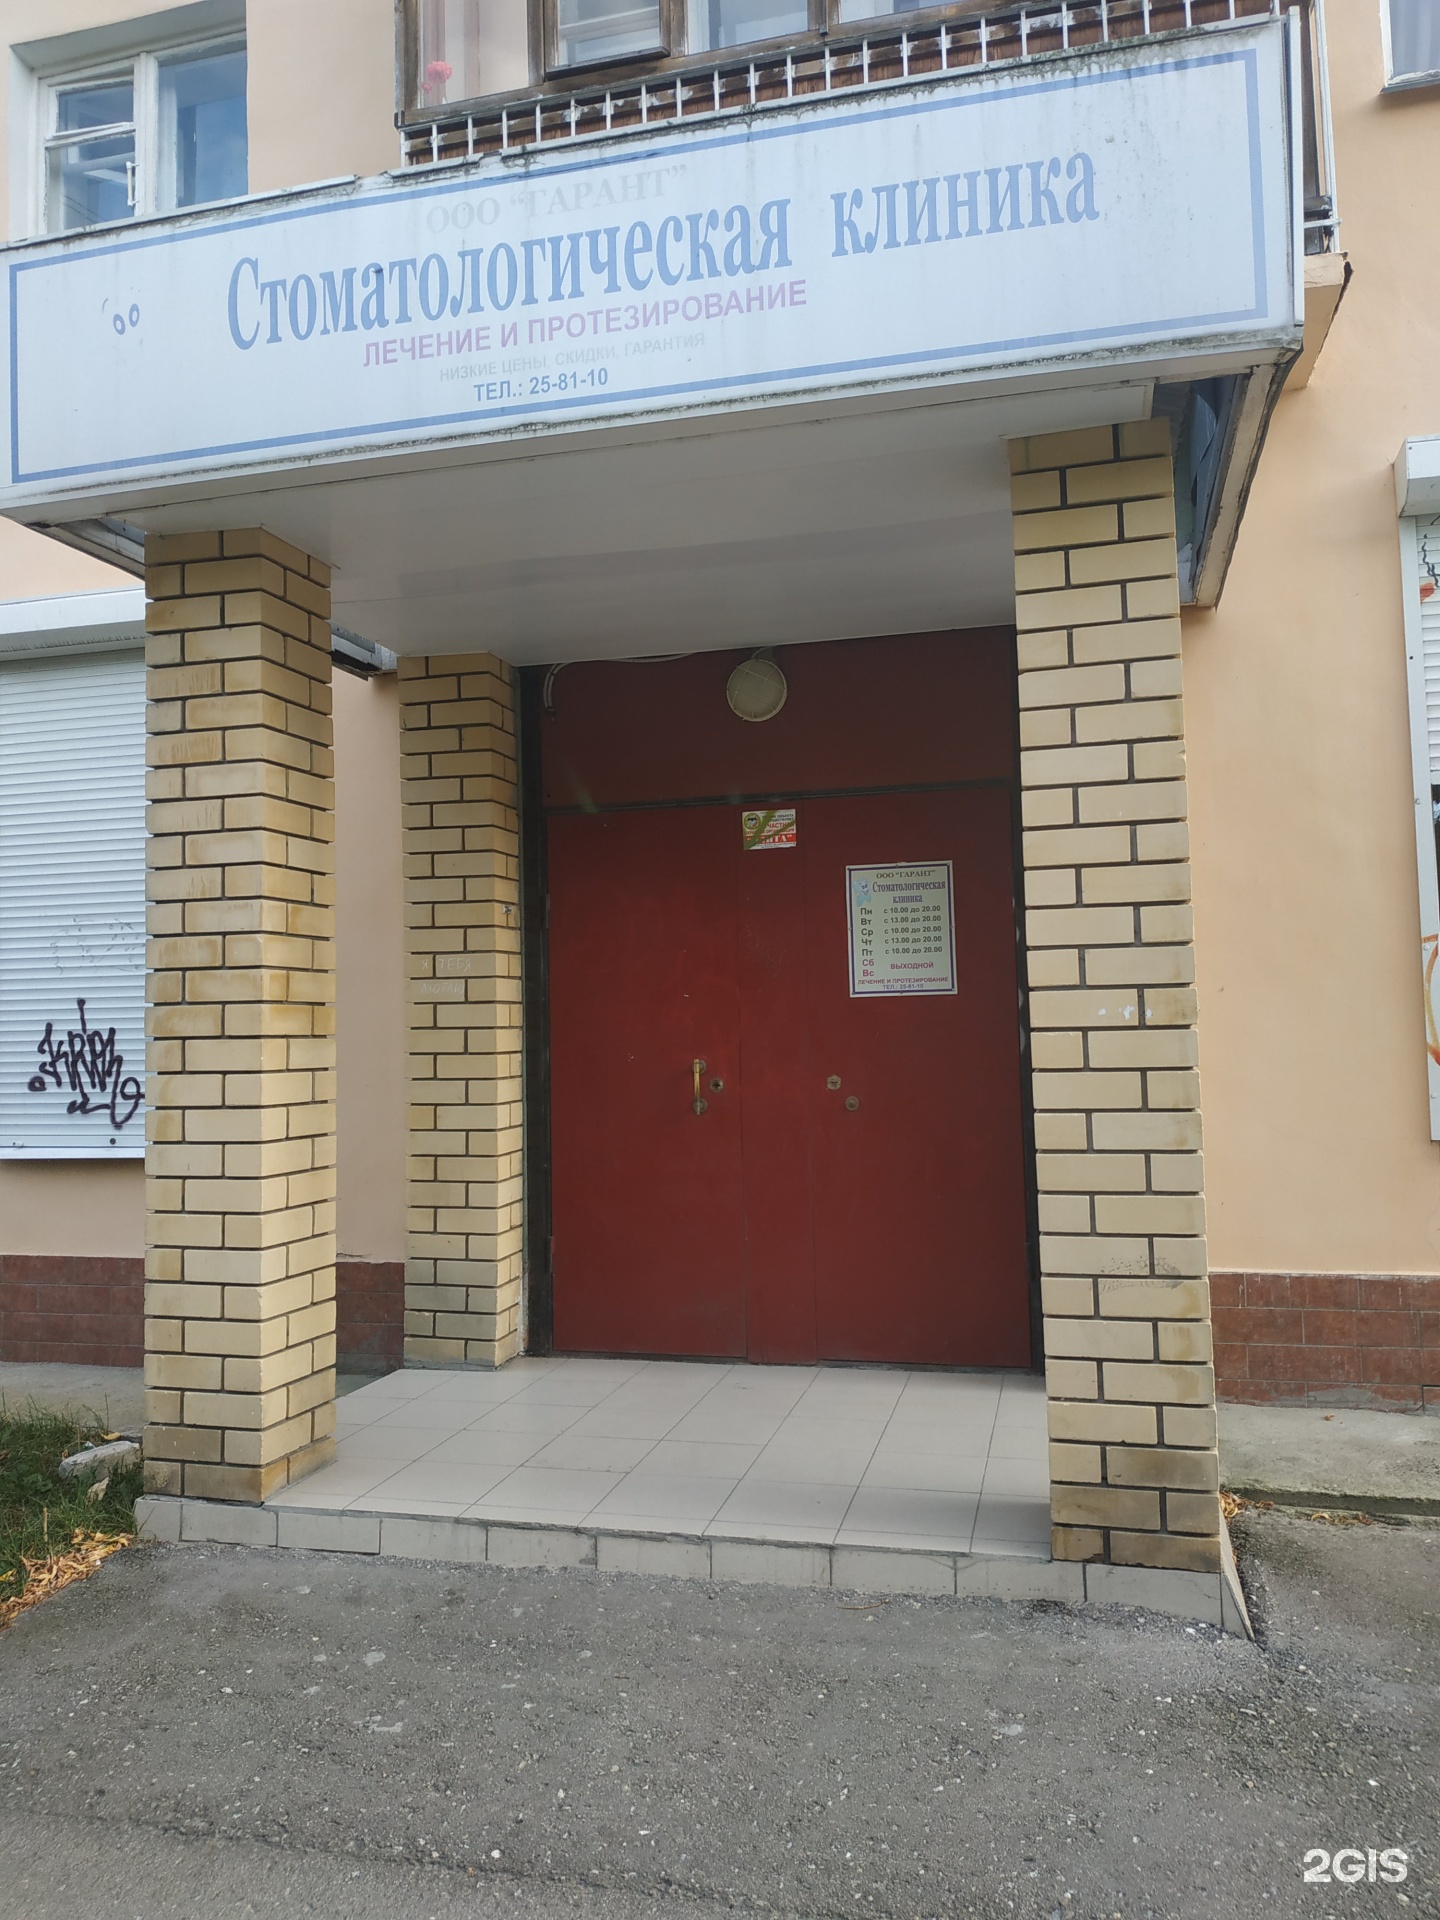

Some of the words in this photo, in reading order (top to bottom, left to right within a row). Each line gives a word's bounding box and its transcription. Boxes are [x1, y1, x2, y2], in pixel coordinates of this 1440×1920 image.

[426, 197, 500, 233] ООО
[228, 198, 792, 350] Стоматологическая
[830, 152, 1099, 257] клиника
[363, 326, 491, 367] ЛЕЧЕНИЕ
[501, 322, 518, 347] И
[528, 279, 807, 344] ПРОТЕЗИРОВАНИЕ
[440, 359, 497, 381] НИЗКИЕ
[625, 332, 705, 356] ГАРАНТИЯ
[474, 380, 523, 401] ТЕЛ.:
[529, 367, 608, 395] 25-81-10
[873, 881, 945, 892] Стоматологическая
[893, 895, 922, 903] клиника
[861, 928, 873, 937] Ср
[890, 961, 934, 970] ВЫХОДНОЙ
